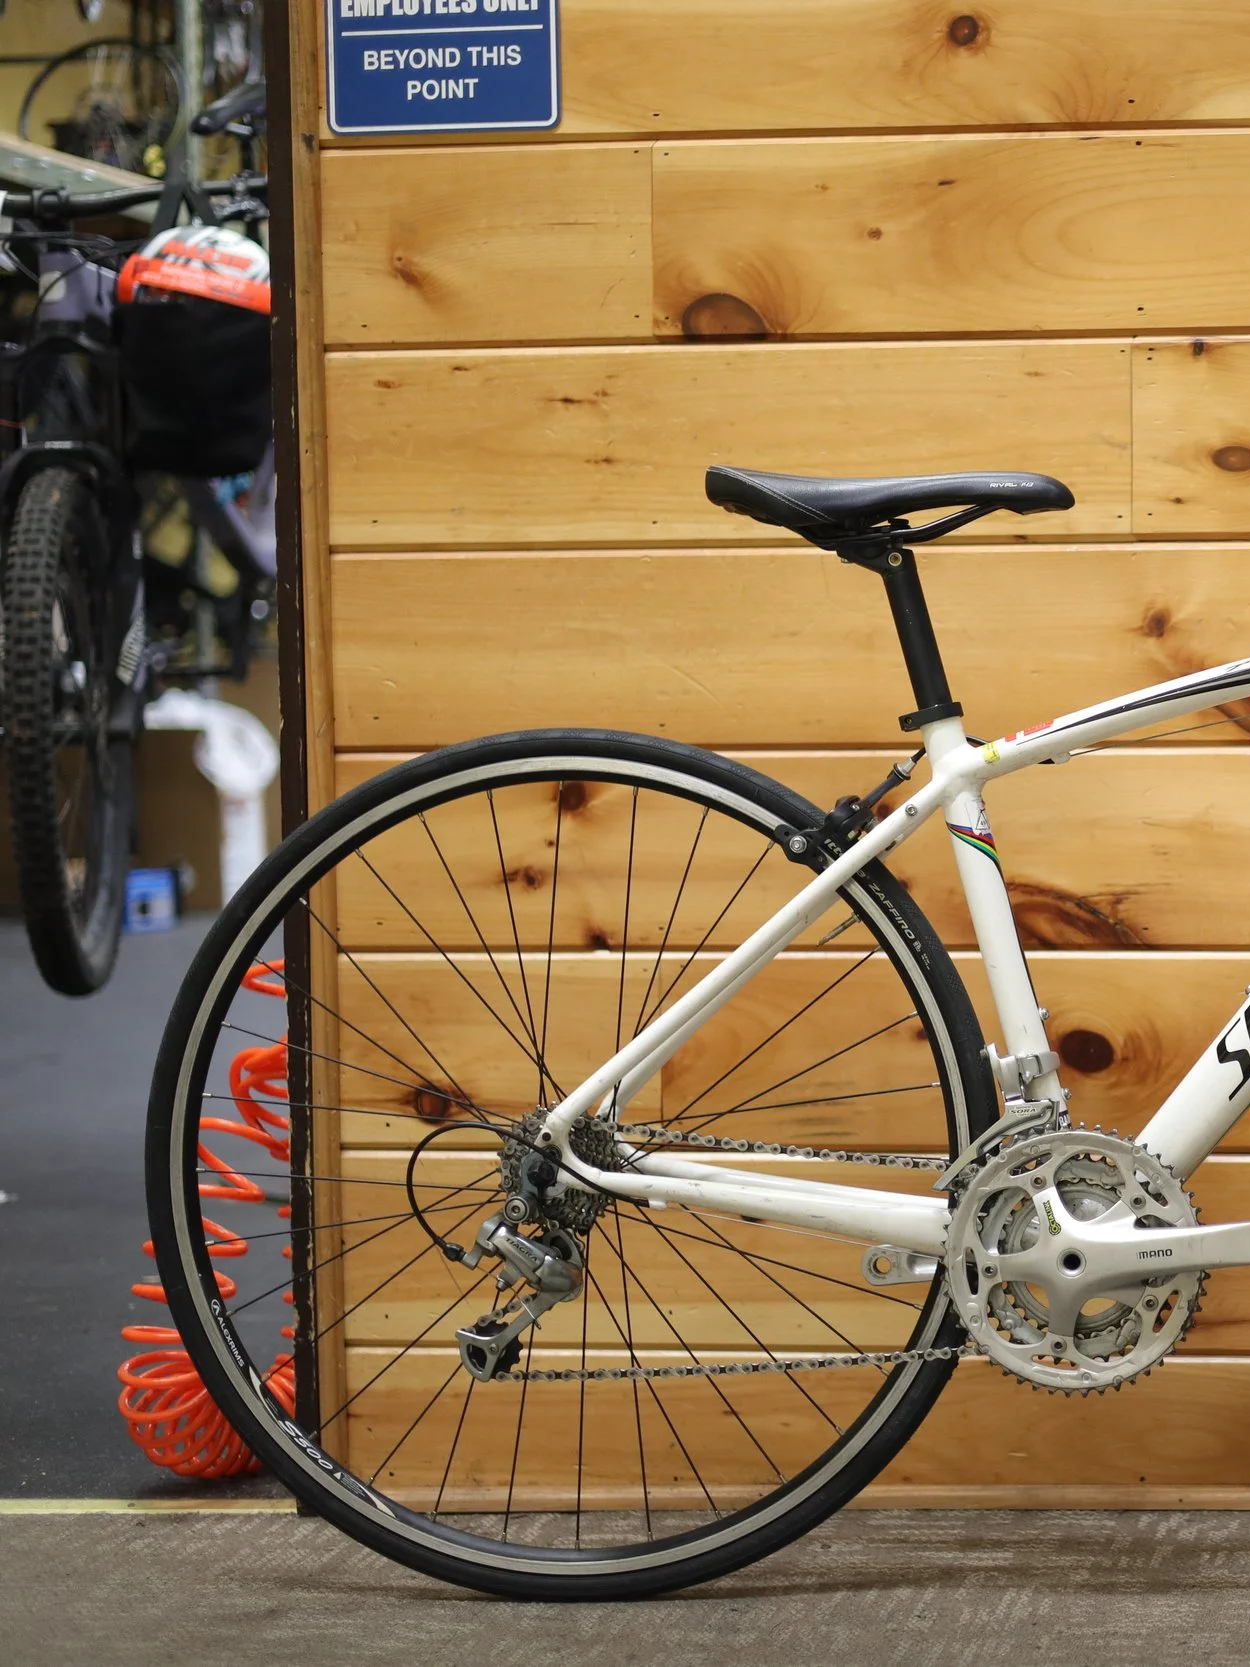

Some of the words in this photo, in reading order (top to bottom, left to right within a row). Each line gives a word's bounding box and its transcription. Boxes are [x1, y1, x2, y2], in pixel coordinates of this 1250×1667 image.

[363, 48, 461, 71] BEYOND
[467, 45, 522, 67] THIS
[407, 78, 479, 101] POINT
[868, 882, 915, 940] ZAFFIRO
[505, 1237, 538, 1263] TIAGRA
[217, 1316, 245, 1368] ALEXRIMS
